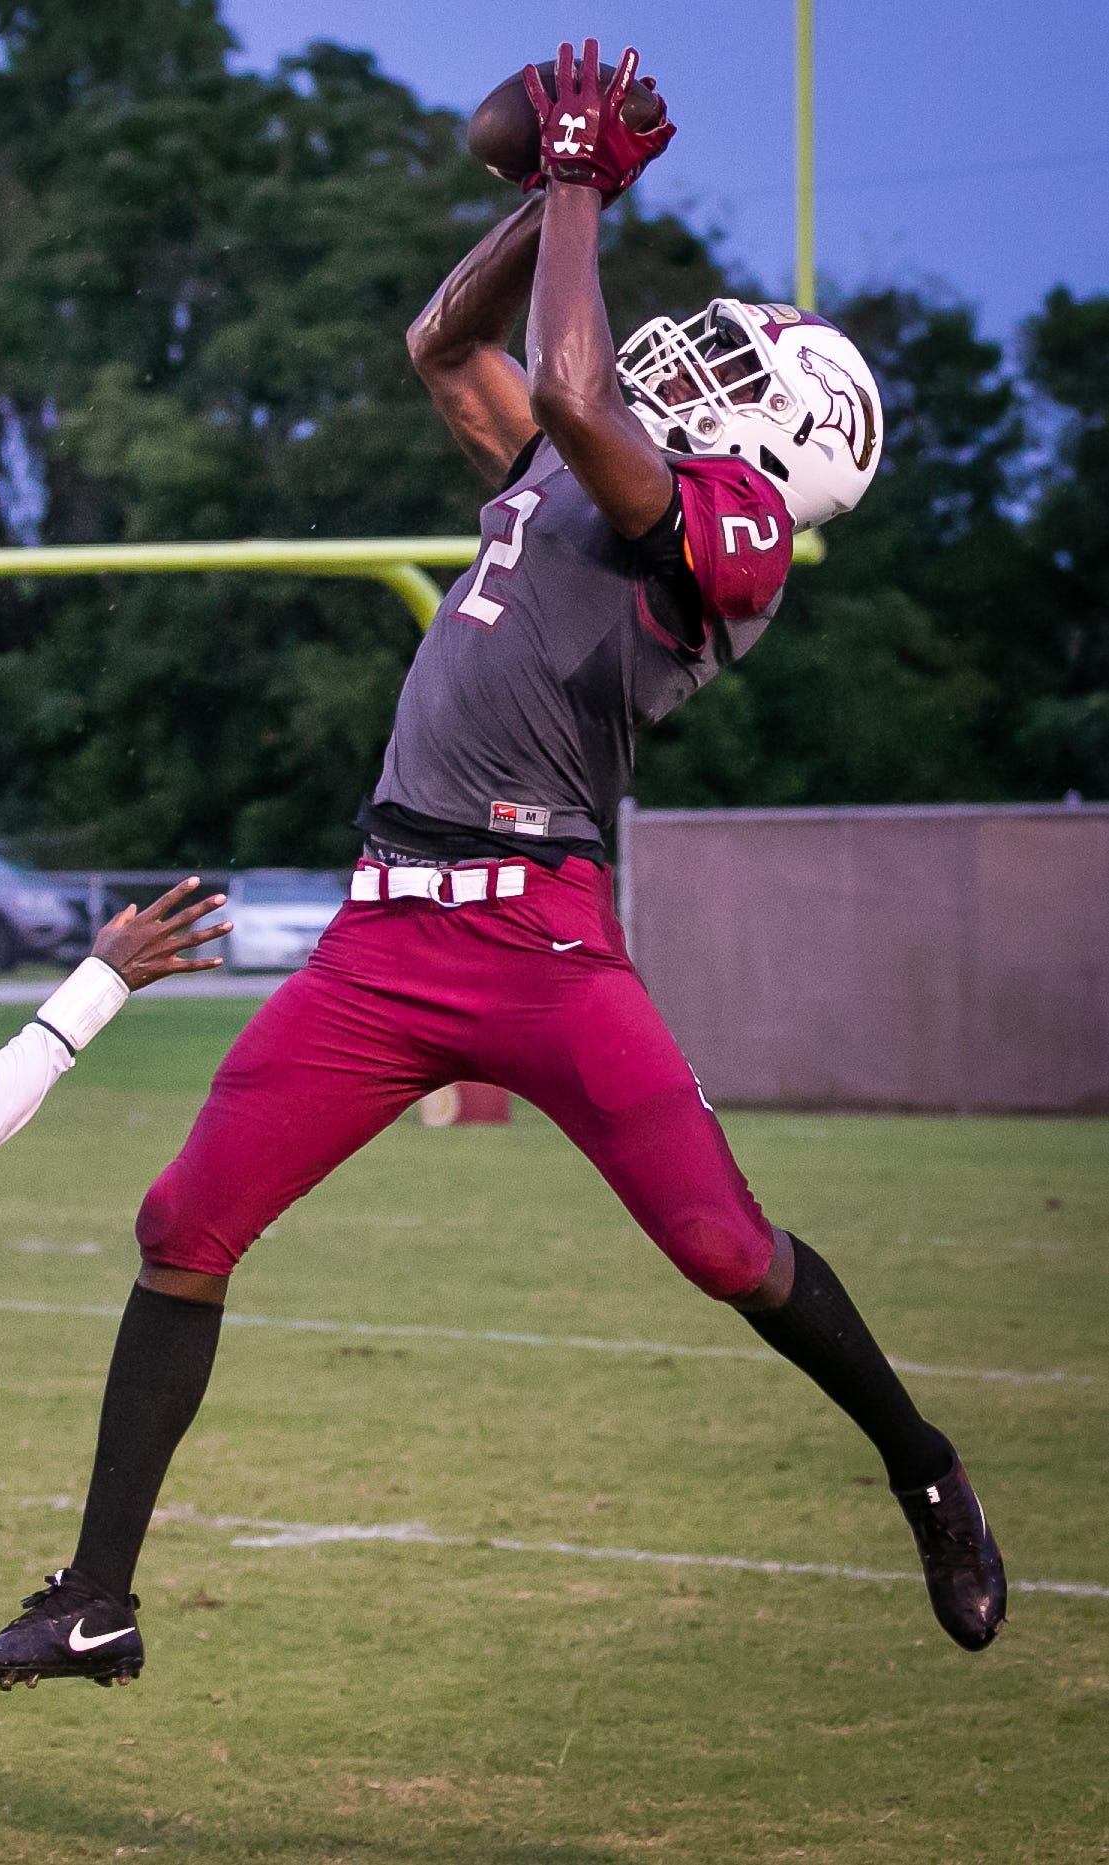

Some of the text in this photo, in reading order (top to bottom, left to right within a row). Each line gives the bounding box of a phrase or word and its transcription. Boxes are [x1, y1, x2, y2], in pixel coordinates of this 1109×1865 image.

[719, 513, 781, 556] 2
[452, 487, 547, 631] 2
[525, 811, 537, 822] M
